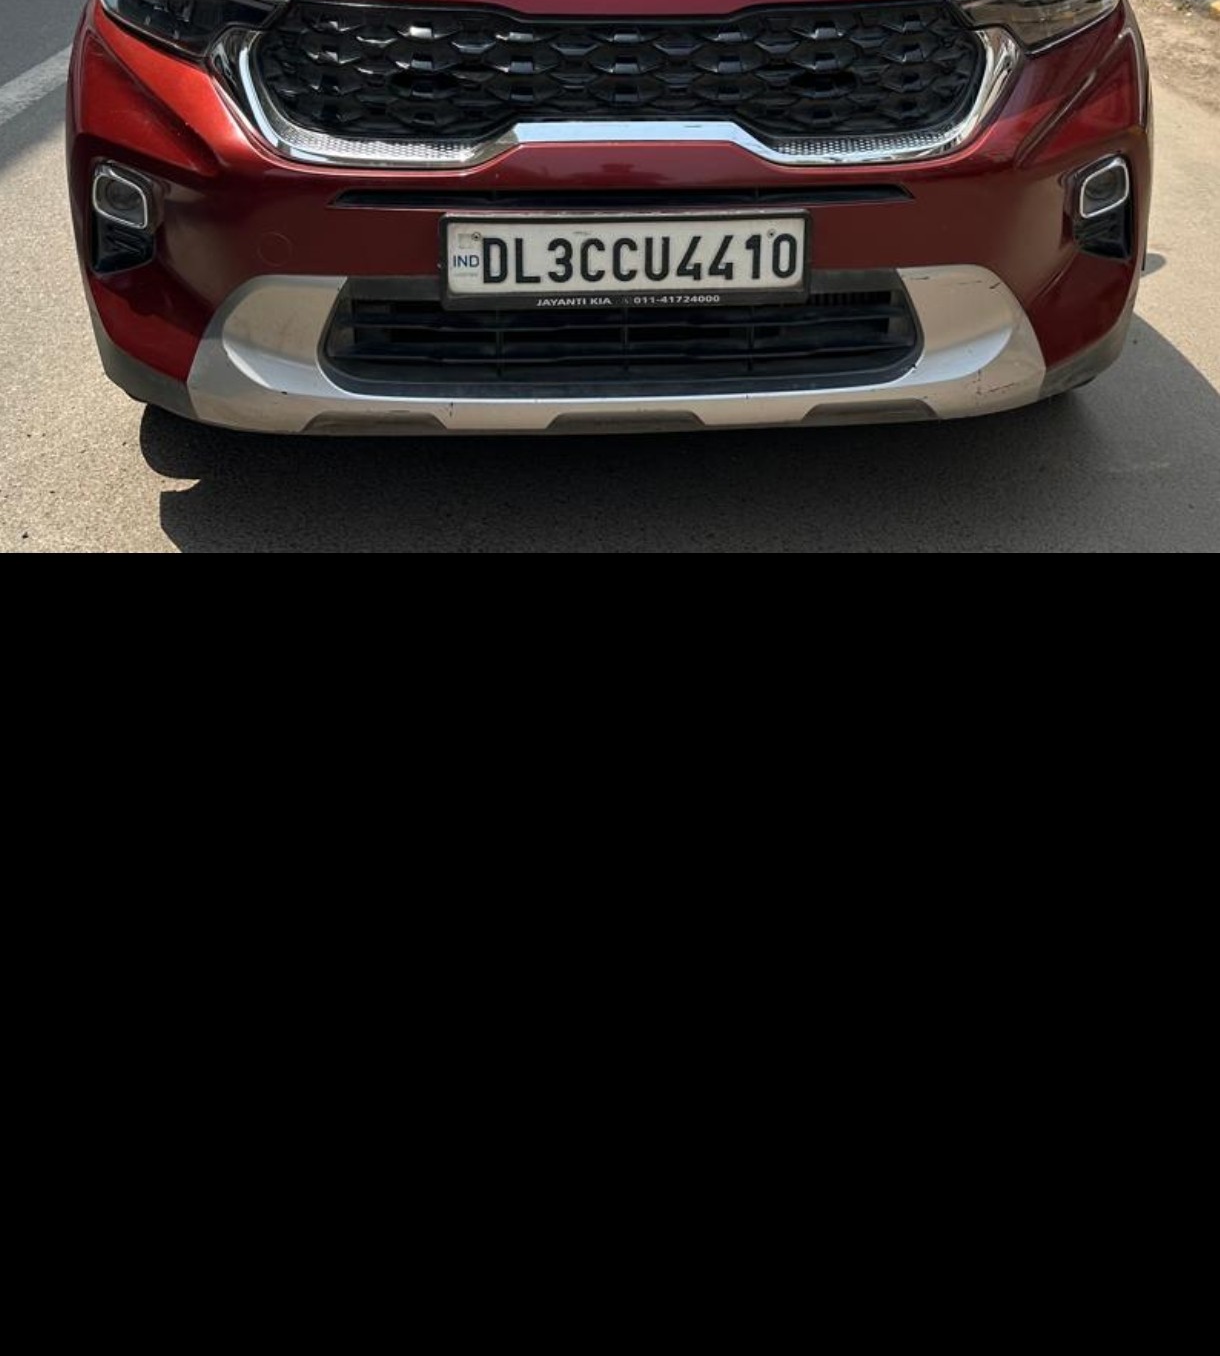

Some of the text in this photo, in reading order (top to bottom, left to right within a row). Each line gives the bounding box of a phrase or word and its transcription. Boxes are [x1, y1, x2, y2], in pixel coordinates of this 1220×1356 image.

[453, 255, 480, 268] IND
[482, 234, 797, 284] DL3CCU4410
[536, 294, 720, 307] JAYANTI KIA 011-41724000
